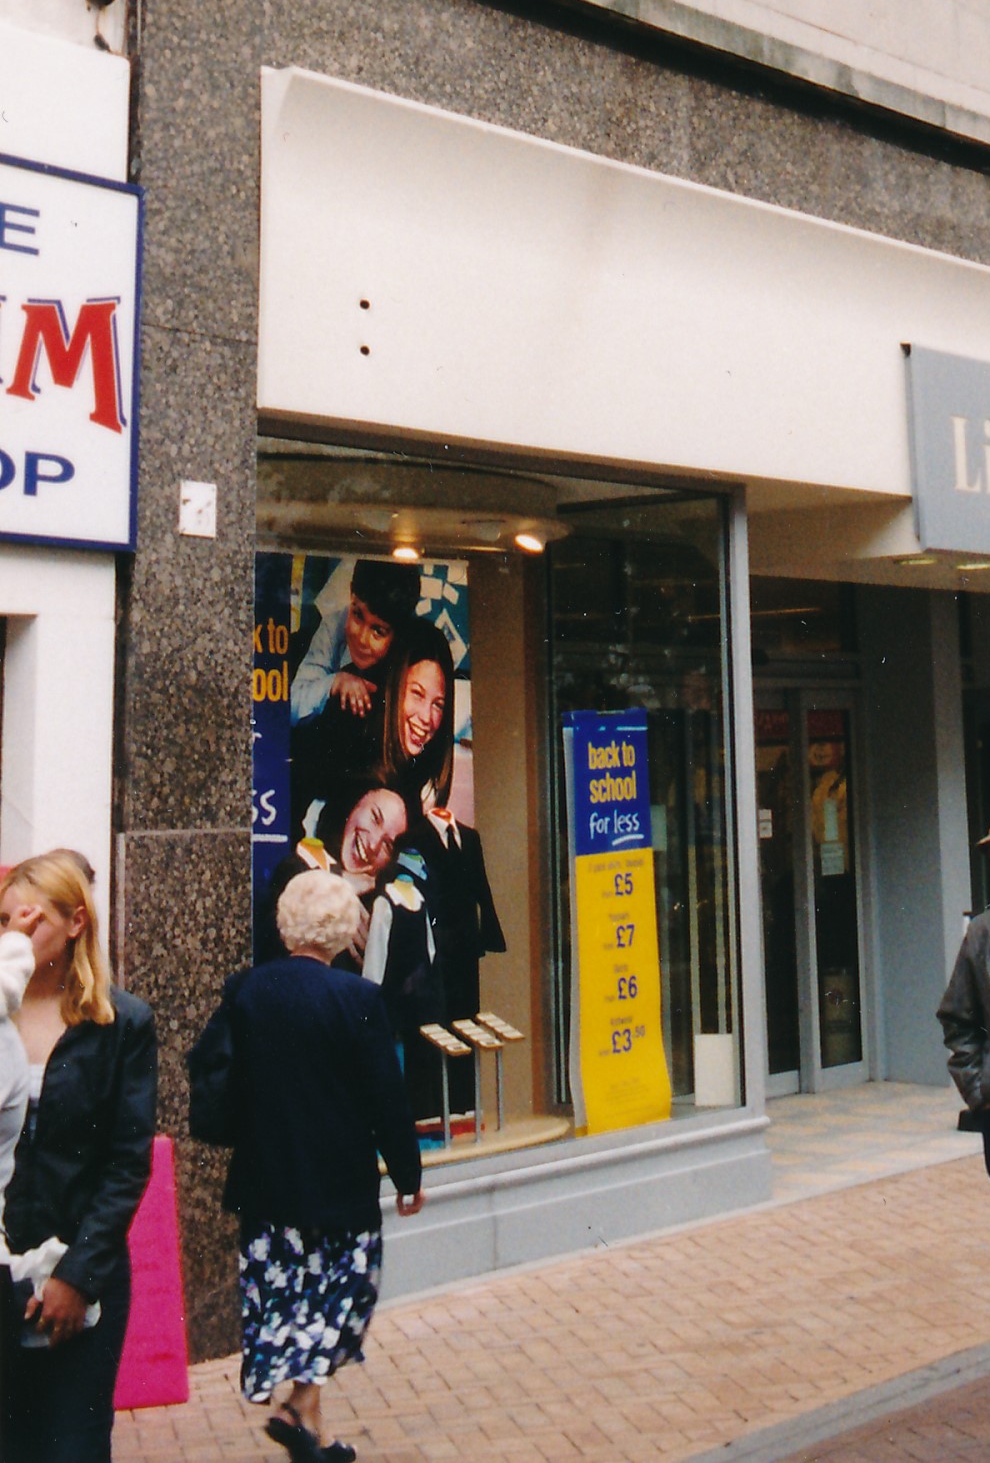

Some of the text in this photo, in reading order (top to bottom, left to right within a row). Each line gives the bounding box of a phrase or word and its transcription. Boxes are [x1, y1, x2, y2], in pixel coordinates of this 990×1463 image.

[0, 296, 127, 435] M
[0, 448, 76, 497] P
[267, 616, 289, 655] to
[588, 740, 636, 770] back to
[589, 769, 638, 805] school
[589, 809, 640, 840] for less
[613, 872, 634, 897] £5
[615, 923, 636, 949] £7
[617, 975, 638, 1000] £6
